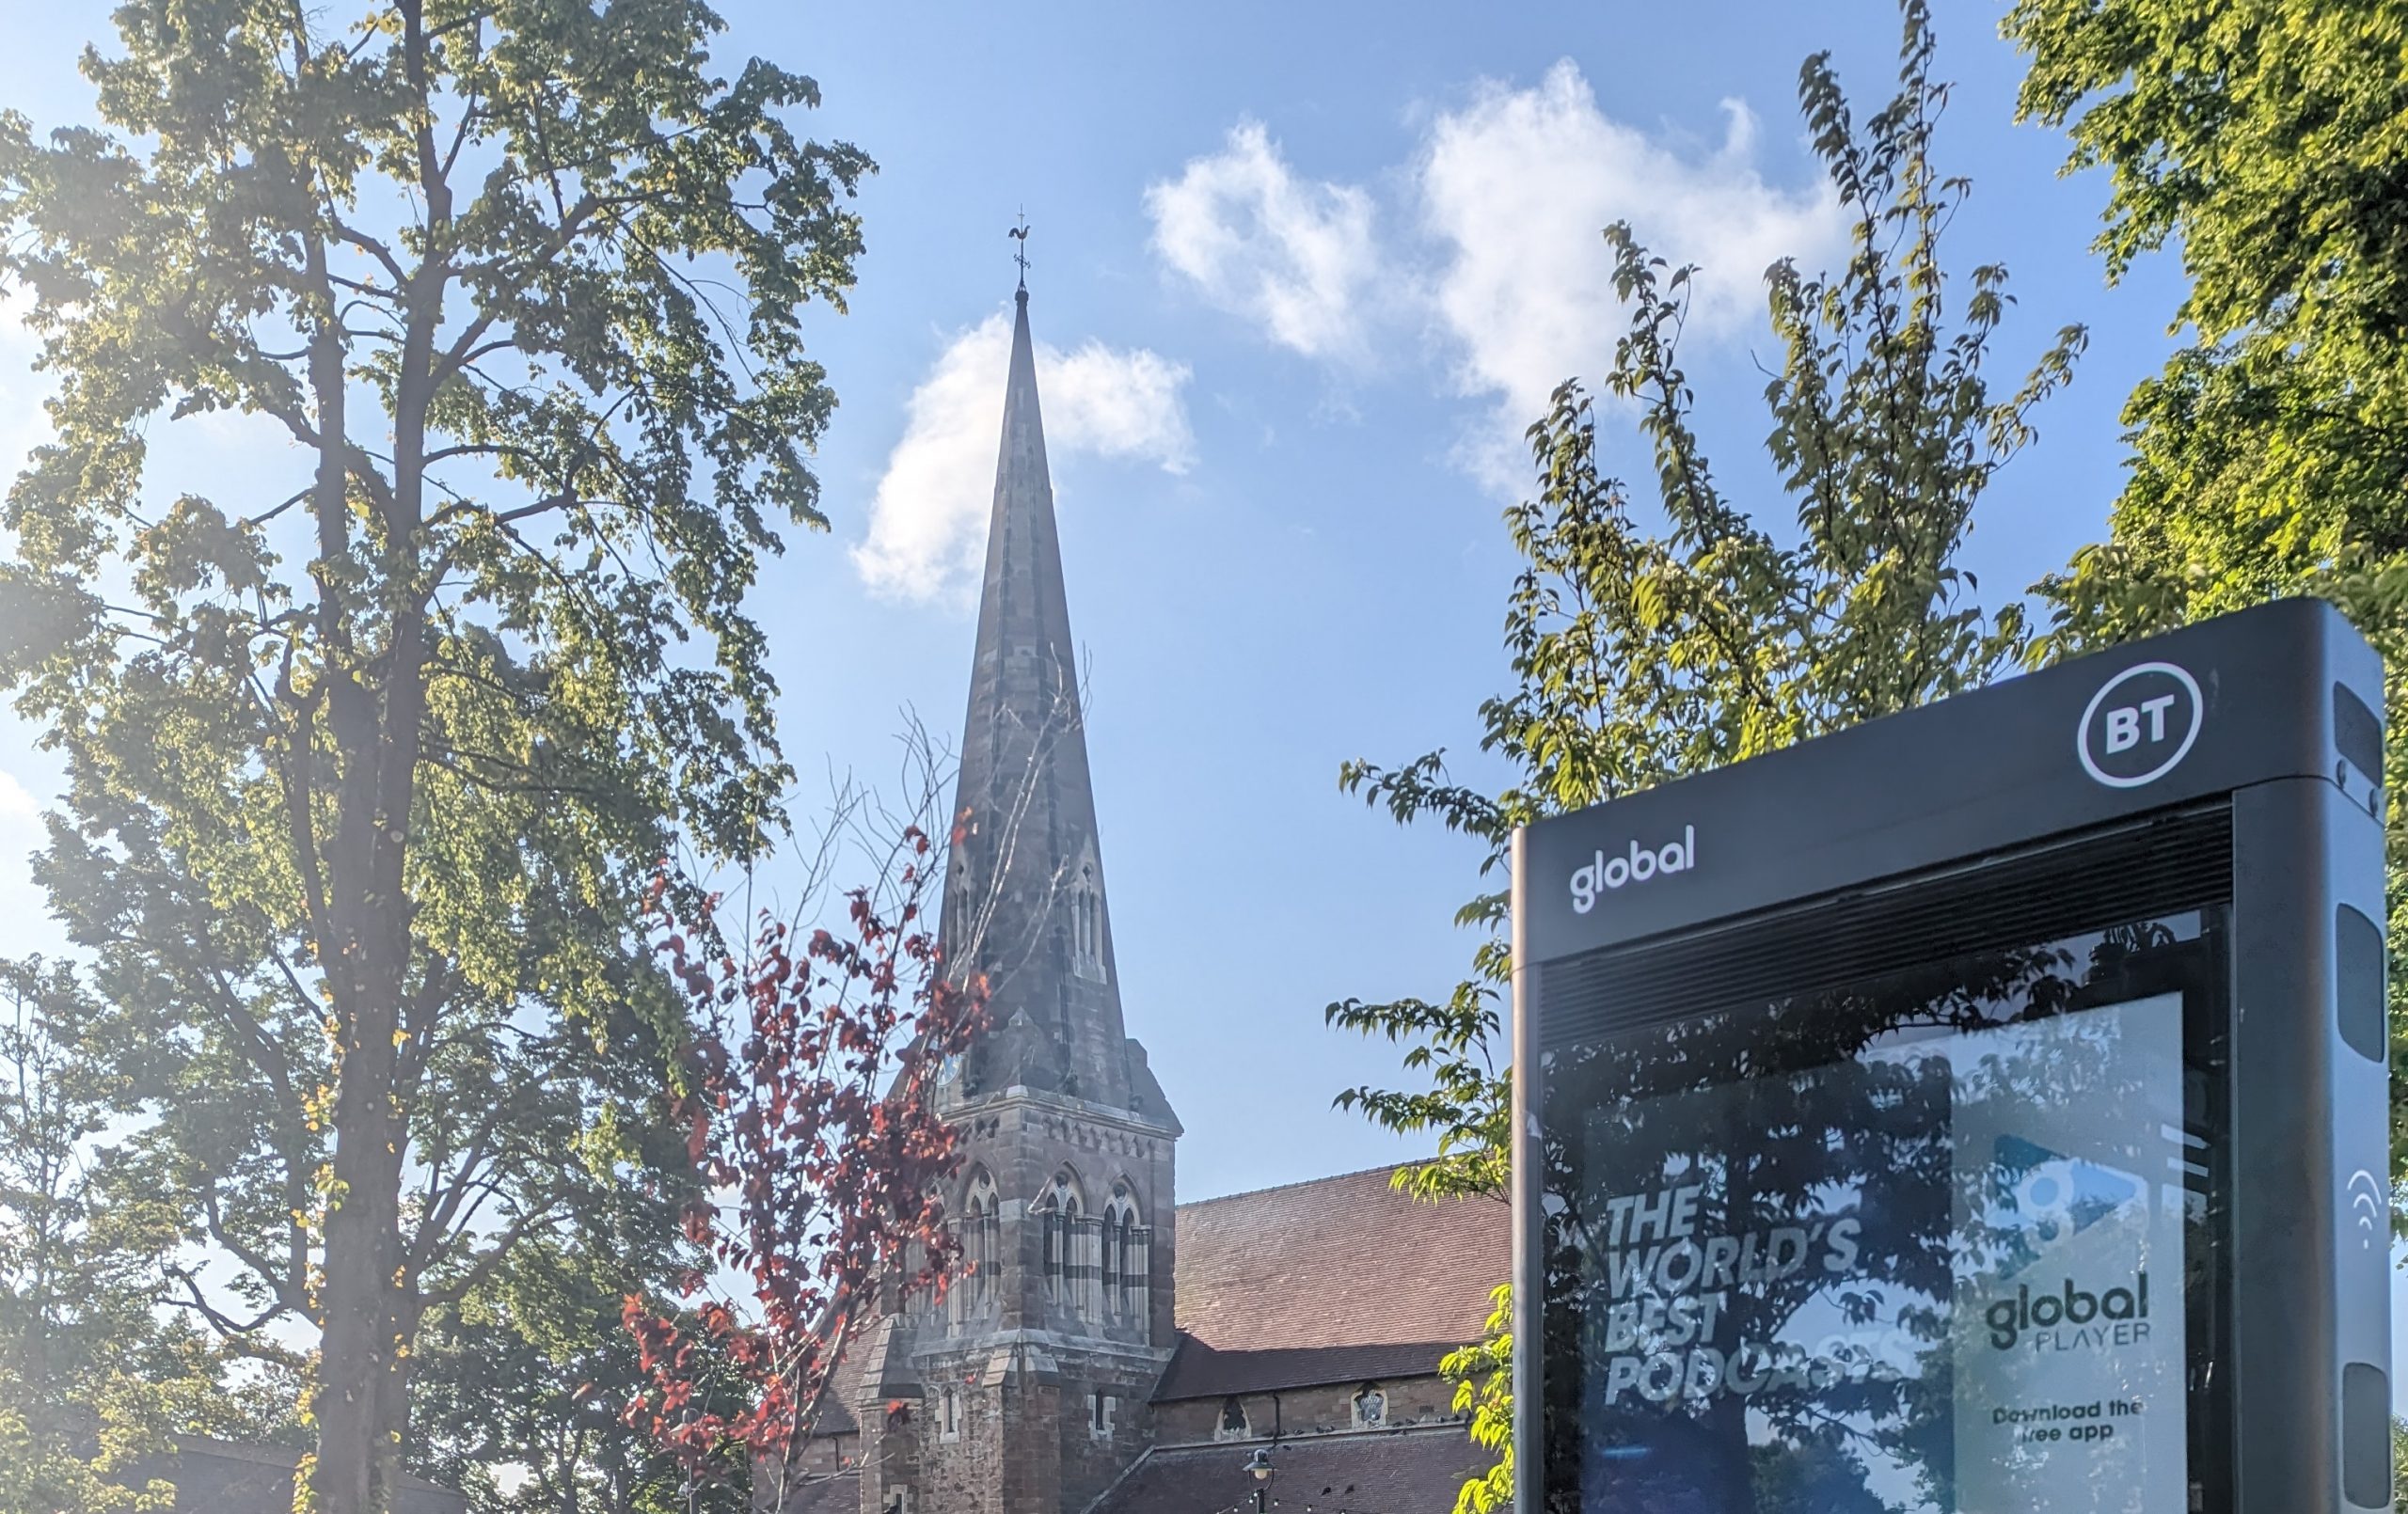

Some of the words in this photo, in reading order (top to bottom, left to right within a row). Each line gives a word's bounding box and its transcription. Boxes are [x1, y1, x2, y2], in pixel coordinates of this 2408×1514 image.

[2106, 694, 2175, 755] BT
[1570, 825, 1694, 914] global
[1606, 1185, 1701, 1246] THE
[1605, 1291, 1720, 1352] BEST
[1986, 1271, 2148, 1350] global
[2036, 1322, 2150, 1352] PLAYER
[1992, 1400, 2100, 1425] Download
[2109, 1399, 2144, 1416] the
[2069, 1424, 2114, 1442] app
